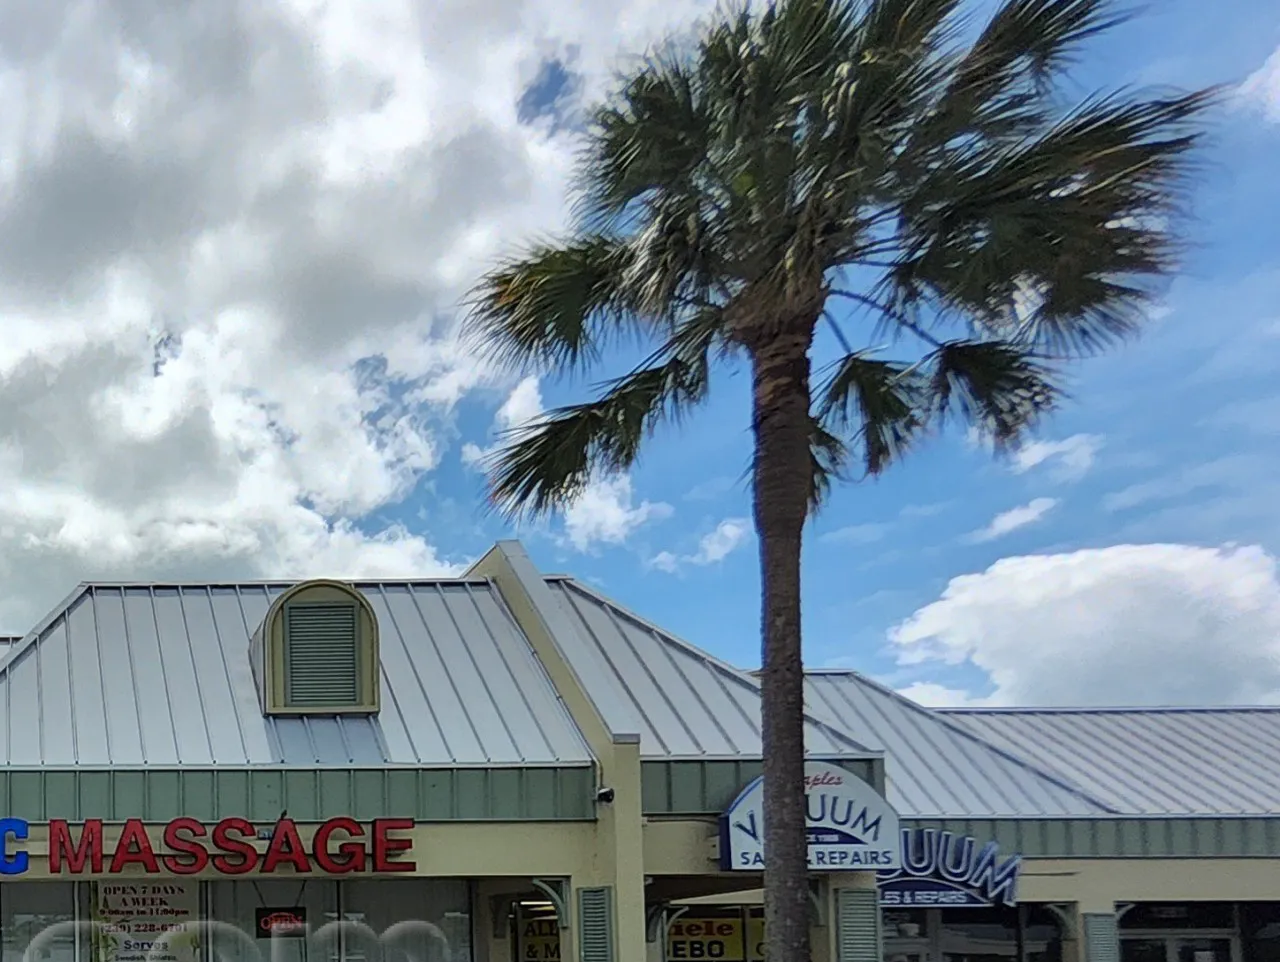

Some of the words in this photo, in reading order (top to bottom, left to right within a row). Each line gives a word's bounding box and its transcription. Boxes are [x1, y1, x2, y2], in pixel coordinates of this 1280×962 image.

[48, 817, 417, 875] MASSAGE
[816, 850, 893, 865] REPAIRS
[103, 885, 137, 895] OPEN
[140, 885, 148, 895] 7
[152, 885, 185, 895] DAYS
[121, 897, 128, 907] A
[131, 897, 169, 907] WEEK
[526, 943, 539, 959] &
